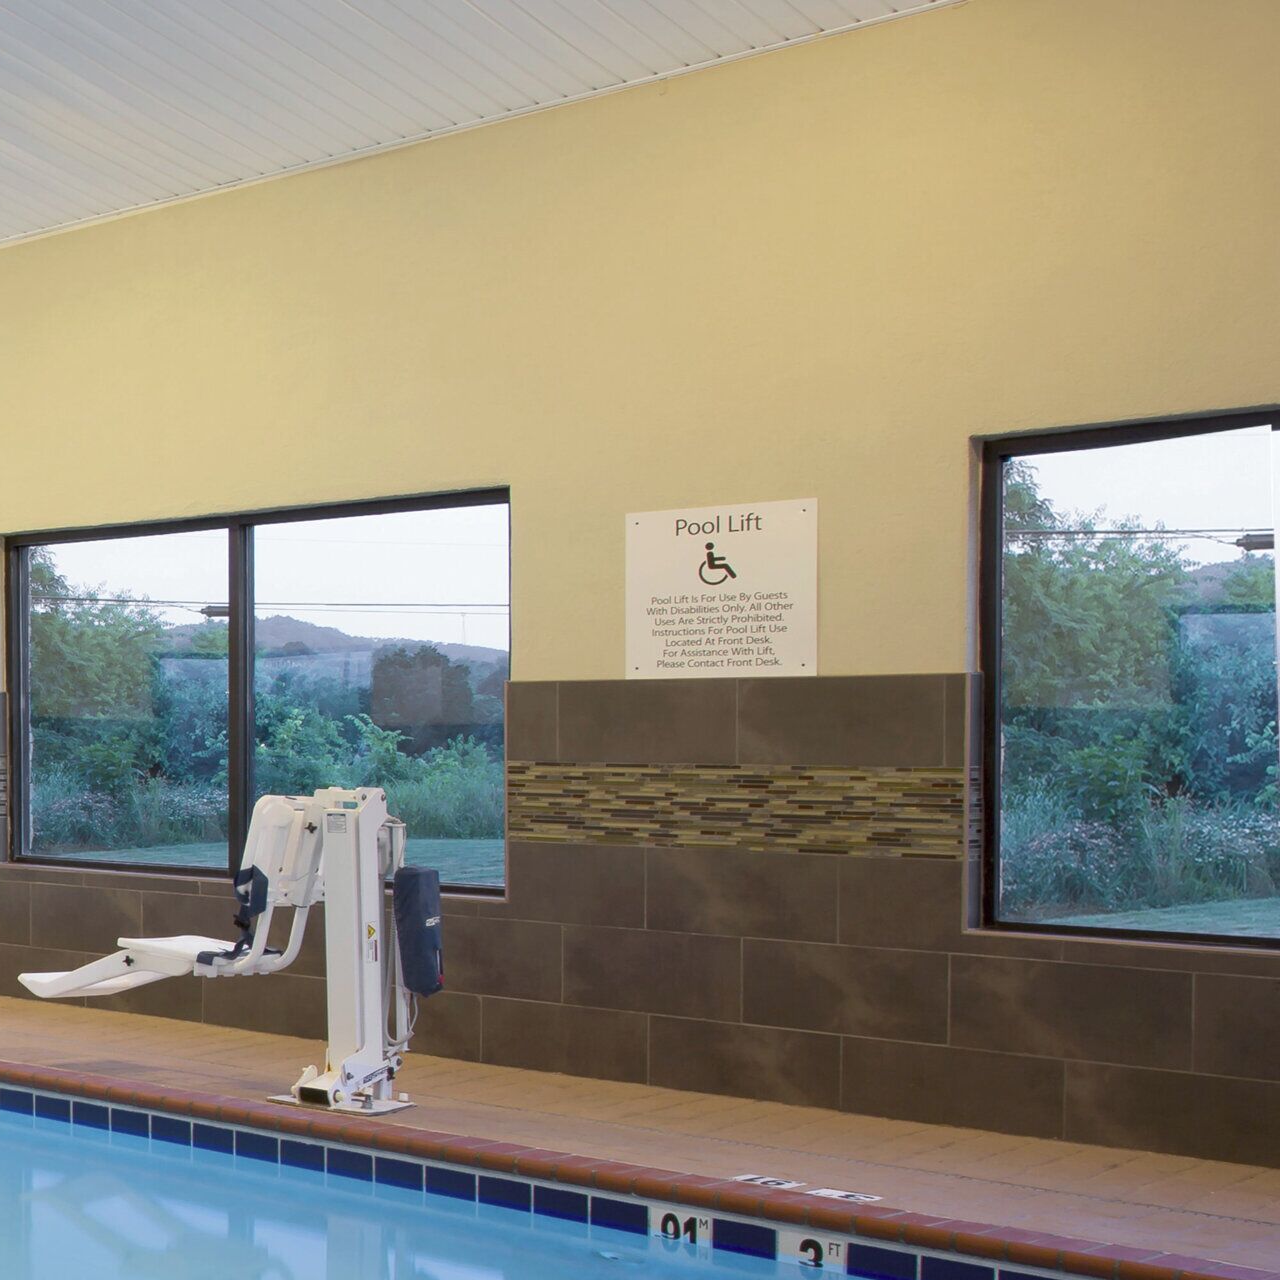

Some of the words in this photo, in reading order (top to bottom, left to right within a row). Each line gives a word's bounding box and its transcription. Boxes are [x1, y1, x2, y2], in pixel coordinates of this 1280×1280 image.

[675, 515, 720, 537] Pool
[728, 512, 763, 533] Lift
[651, 596, 672, 605] Pool
[674, 595, 689, 604] Lift
[691, 595, 698, 603] Is
[700, 594, 716, 603] For
[718, 593, 737, 602] Use
[740, 592, 752, 602] By
[754, 591, 788, 600] Guests
[646, 606, 668, 616] With
[670, 605, 720, 615] Disabilities
[722, 603, 747, 614] Only.
[749, 602, 761, 612] All
[764, 602, 794, 611] Other
[654, 618, 676, 626] Uses
[678, 617, 694, 625] Are
[696, 615, 728, 626] Strictly
[731, 613, 784, 623] Prohibited.
[652, 627, 706, 637] Instructions
[708, 626, 723, 635] For
[726, 625, 748, 634] Pool
[750, 624, 766, 634] Lift
[769, 624, 788, 633] Use
[665, 638, 702, 648] Located
[704, 637, 716, 646] At
[718, 636, 743, 646] Front
[746, 635, 772, 645] Desk.
[663, 649, 678, 658] For
[680, 648, 728, 657] Assistance
[731, 646, 754, 656] With
[756, 646, 776, 656] Lift,
[656, 659, 685, 669] Please
[687, 658, 724, 668] Contact
[727, 658, 752, 667] Front
[755, 657, 783, 666] Desk.
[698, 1218, 708, 1230] M
[828, 1242, 841, 1257] FT
